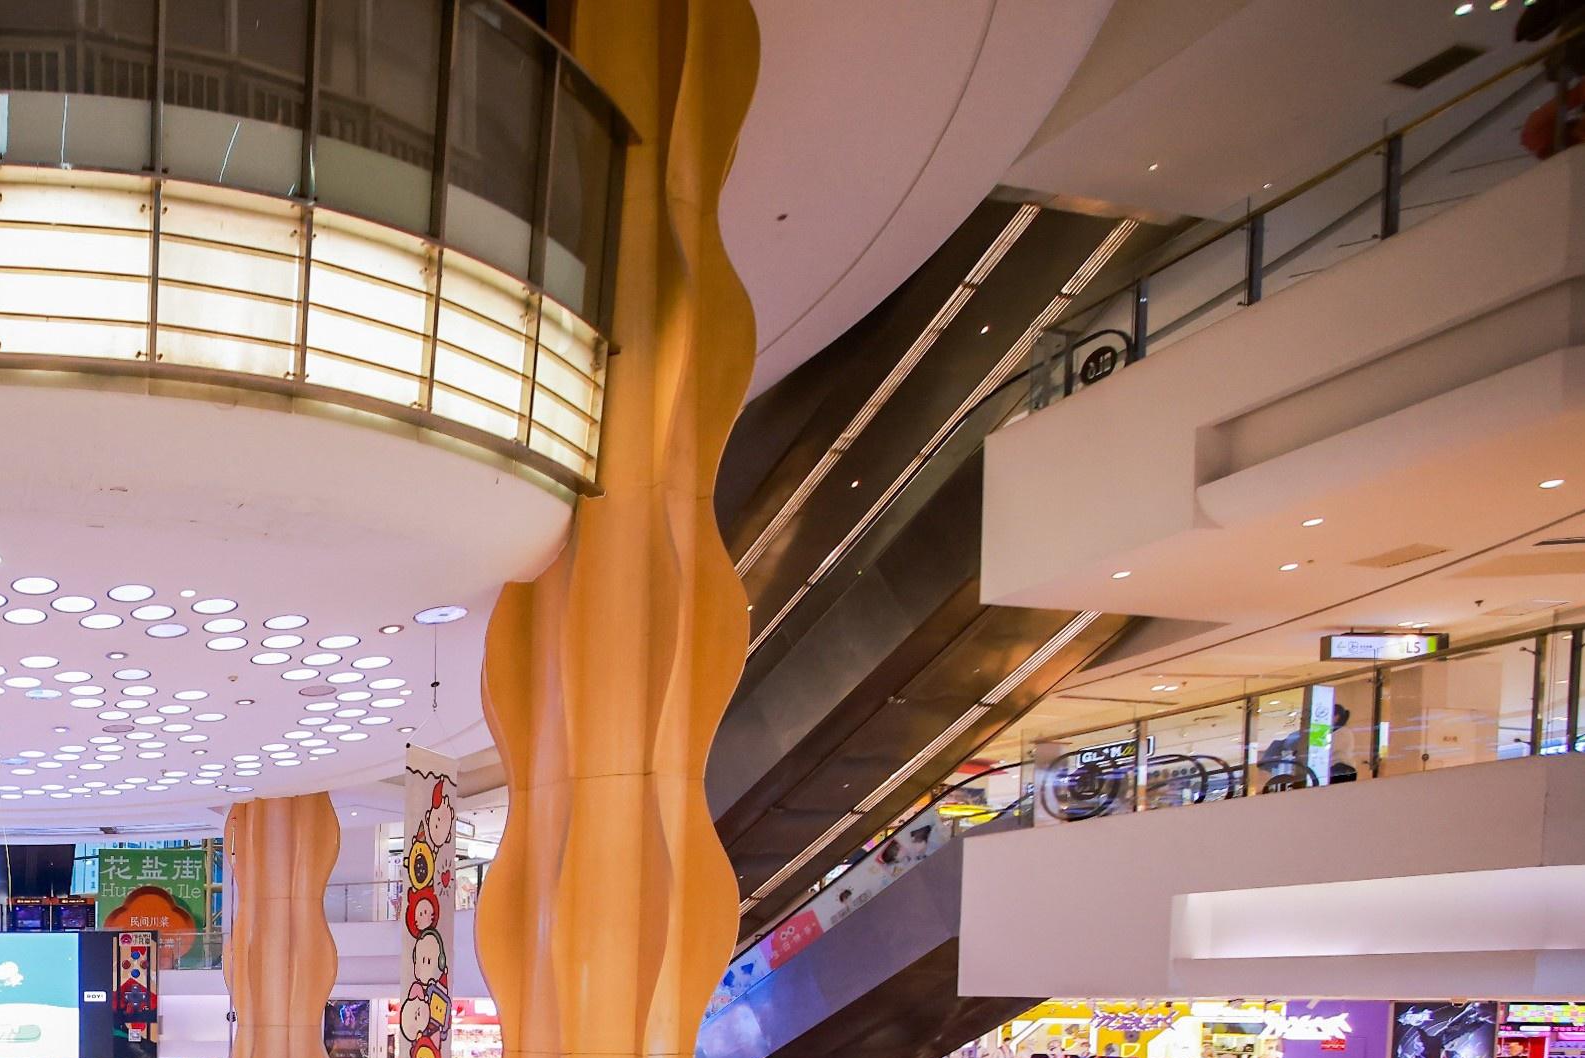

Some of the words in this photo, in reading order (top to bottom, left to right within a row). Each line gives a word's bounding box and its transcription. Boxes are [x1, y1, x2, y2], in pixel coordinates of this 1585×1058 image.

[100, 856, 203, 881] 花盐街
[129, 916, 171, 928] 民间川菜
